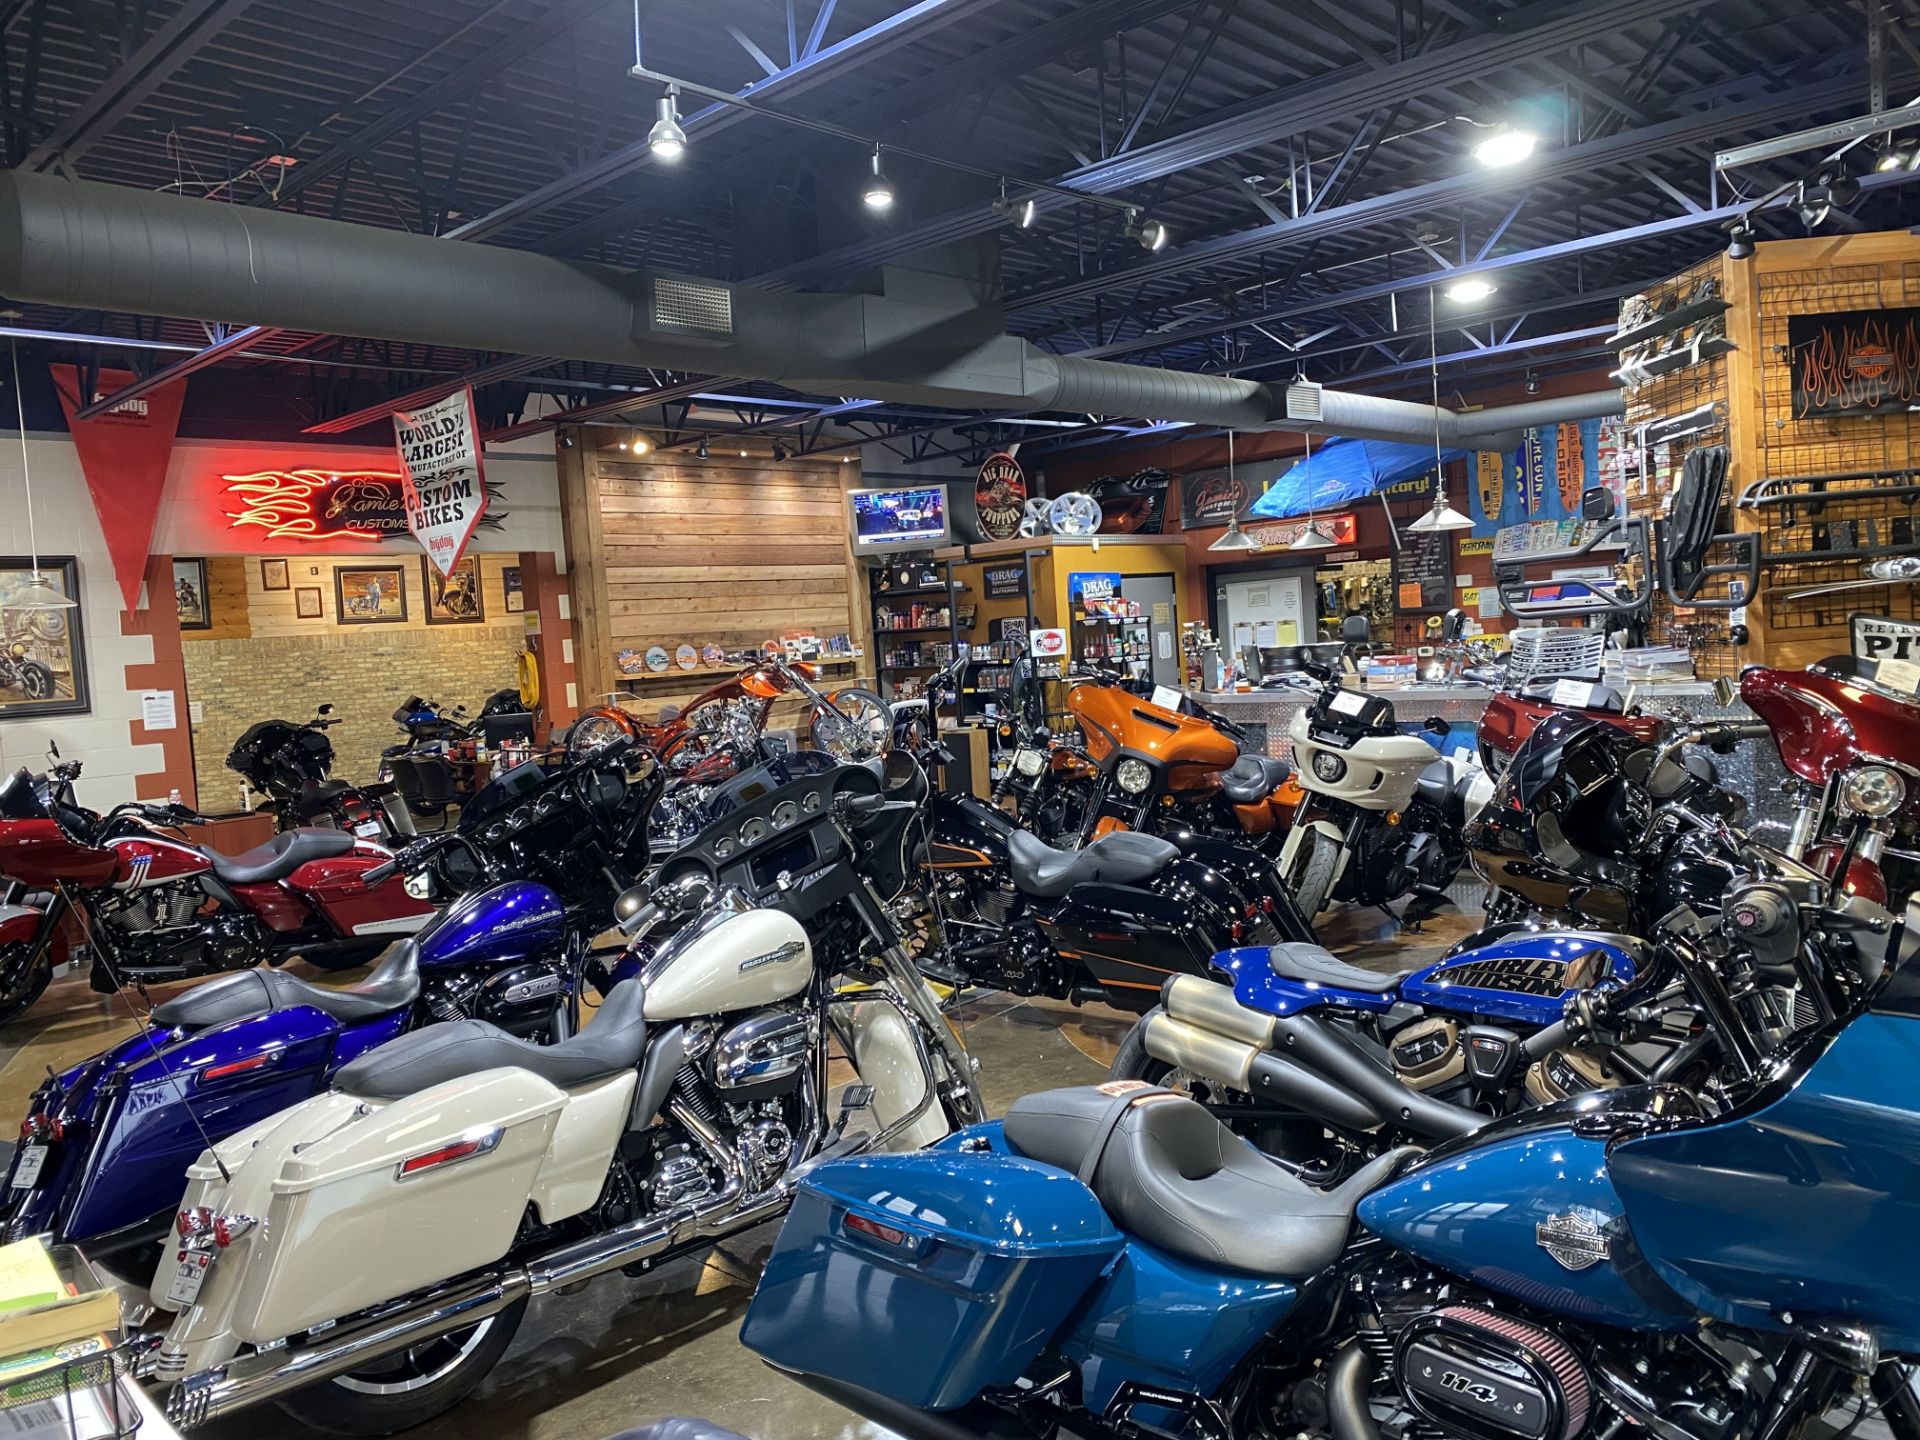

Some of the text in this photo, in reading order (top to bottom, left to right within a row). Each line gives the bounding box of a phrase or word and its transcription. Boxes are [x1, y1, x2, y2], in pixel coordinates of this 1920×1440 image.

[399, 411, 464, 445] WORLD'S
[419, 411, 434, 422] THE
[402, 429, 464, 463] LARGEST
[456, 449, 467, 459] OF
[1557, 428, 1567, 498] FLORIDA
[407, 479, 472, 511] CUSTOM
[345, 519, 409, 530] CUSTOMS
[415, 502, 464, 531] BIKES
[981, 507, 1021, 526] CHOPPERS
[991, 569, 1019, 581] DRAG
[1082, 579, 1113, 593] DRAG
[1864, 635, 1920, 659] PI
[1440, 1371, 1498, 1402] 114
